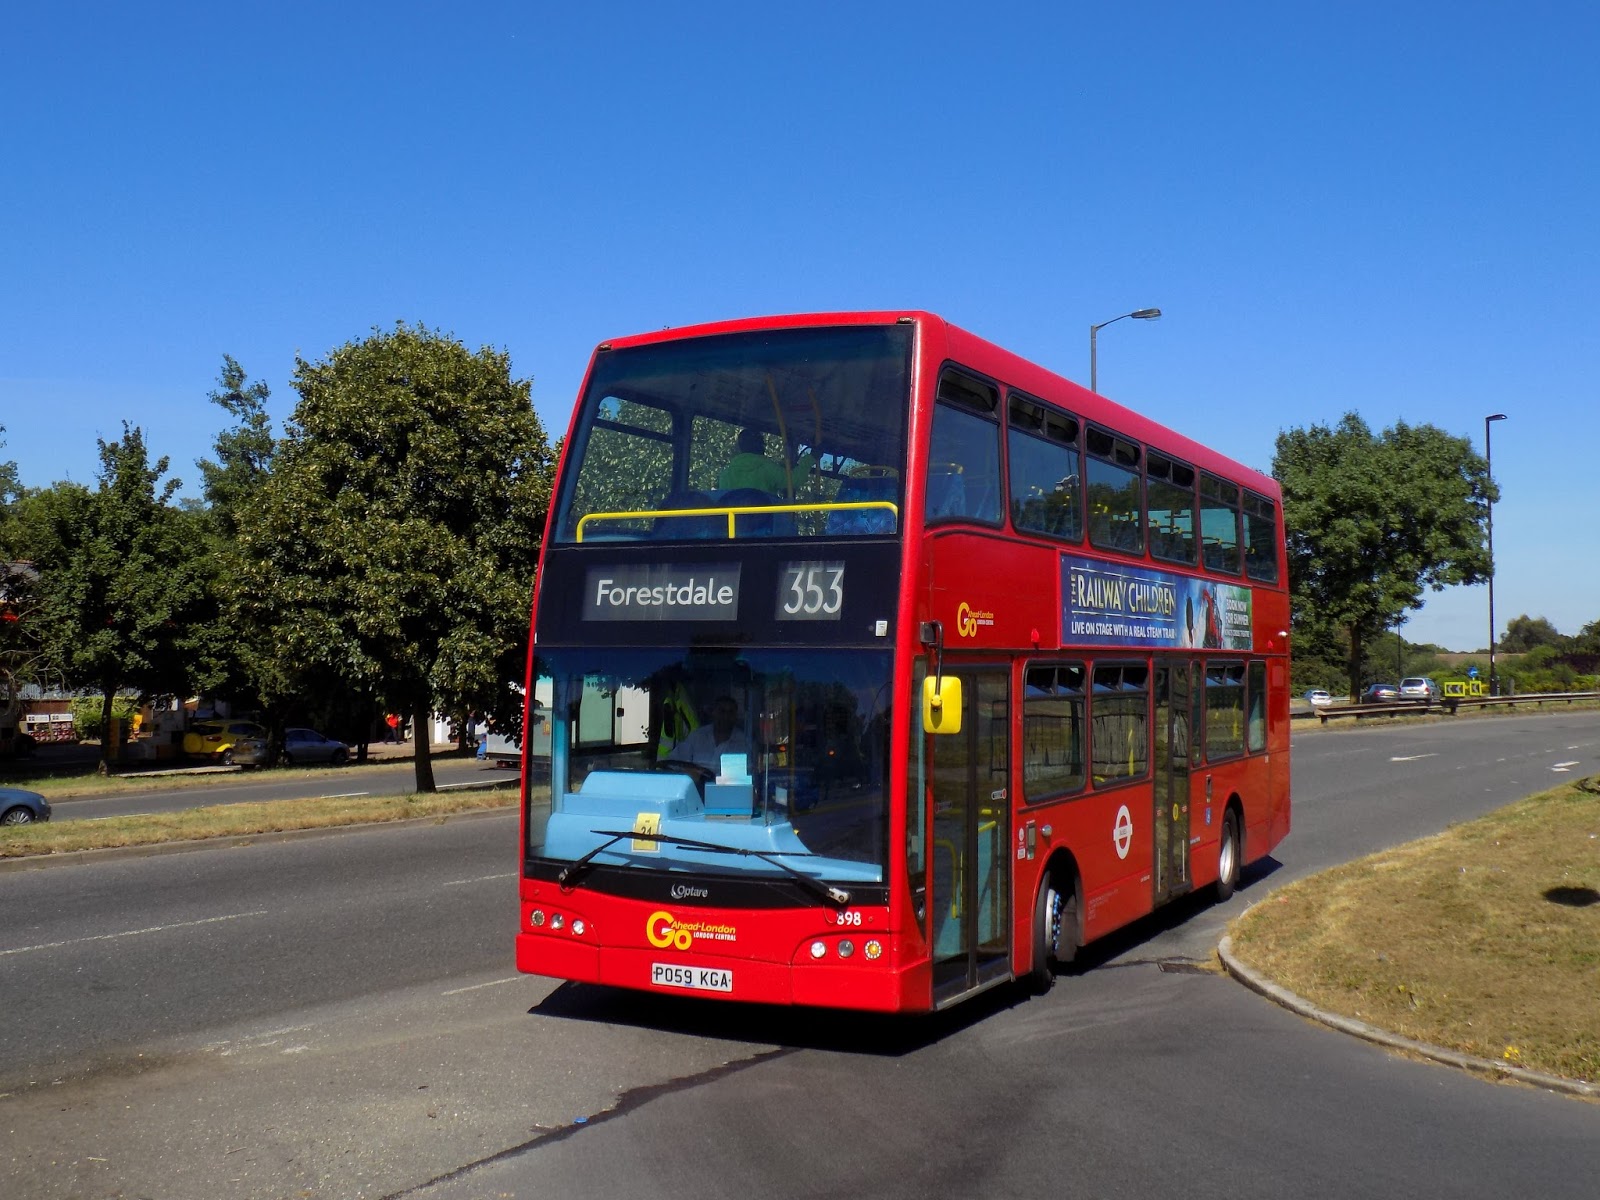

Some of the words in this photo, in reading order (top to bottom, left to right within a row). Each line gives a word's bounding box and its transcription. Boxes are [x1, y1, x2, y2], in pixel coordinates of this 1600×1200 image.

[596, 578, 734, 606] Forestdale
[784, 567, 844, 614] 353
[1078, 574, 1127, 611] RAILWAY
[1128, 582, 1177, 615] CHILDREN
[957, 602, 977, 638] Go
[1071, 621, 1085, 635] LIVE
[1085, 621, 1095, 635] ON
[1095, 622, 1113, 636] STAGE
[1113, 623, 1129, 637] WITH
[1133, 625, 1147, 638] REAL
[1146, 626, 1162, 639] STEAM
[671, 884, 709, 899] Optare
[646, 911, 693, 951] Go
[693, 931, 714, 940] LONDON
[714, 933, 736, 941] CENTRAL
[700, 970, 728, 988] KGA
